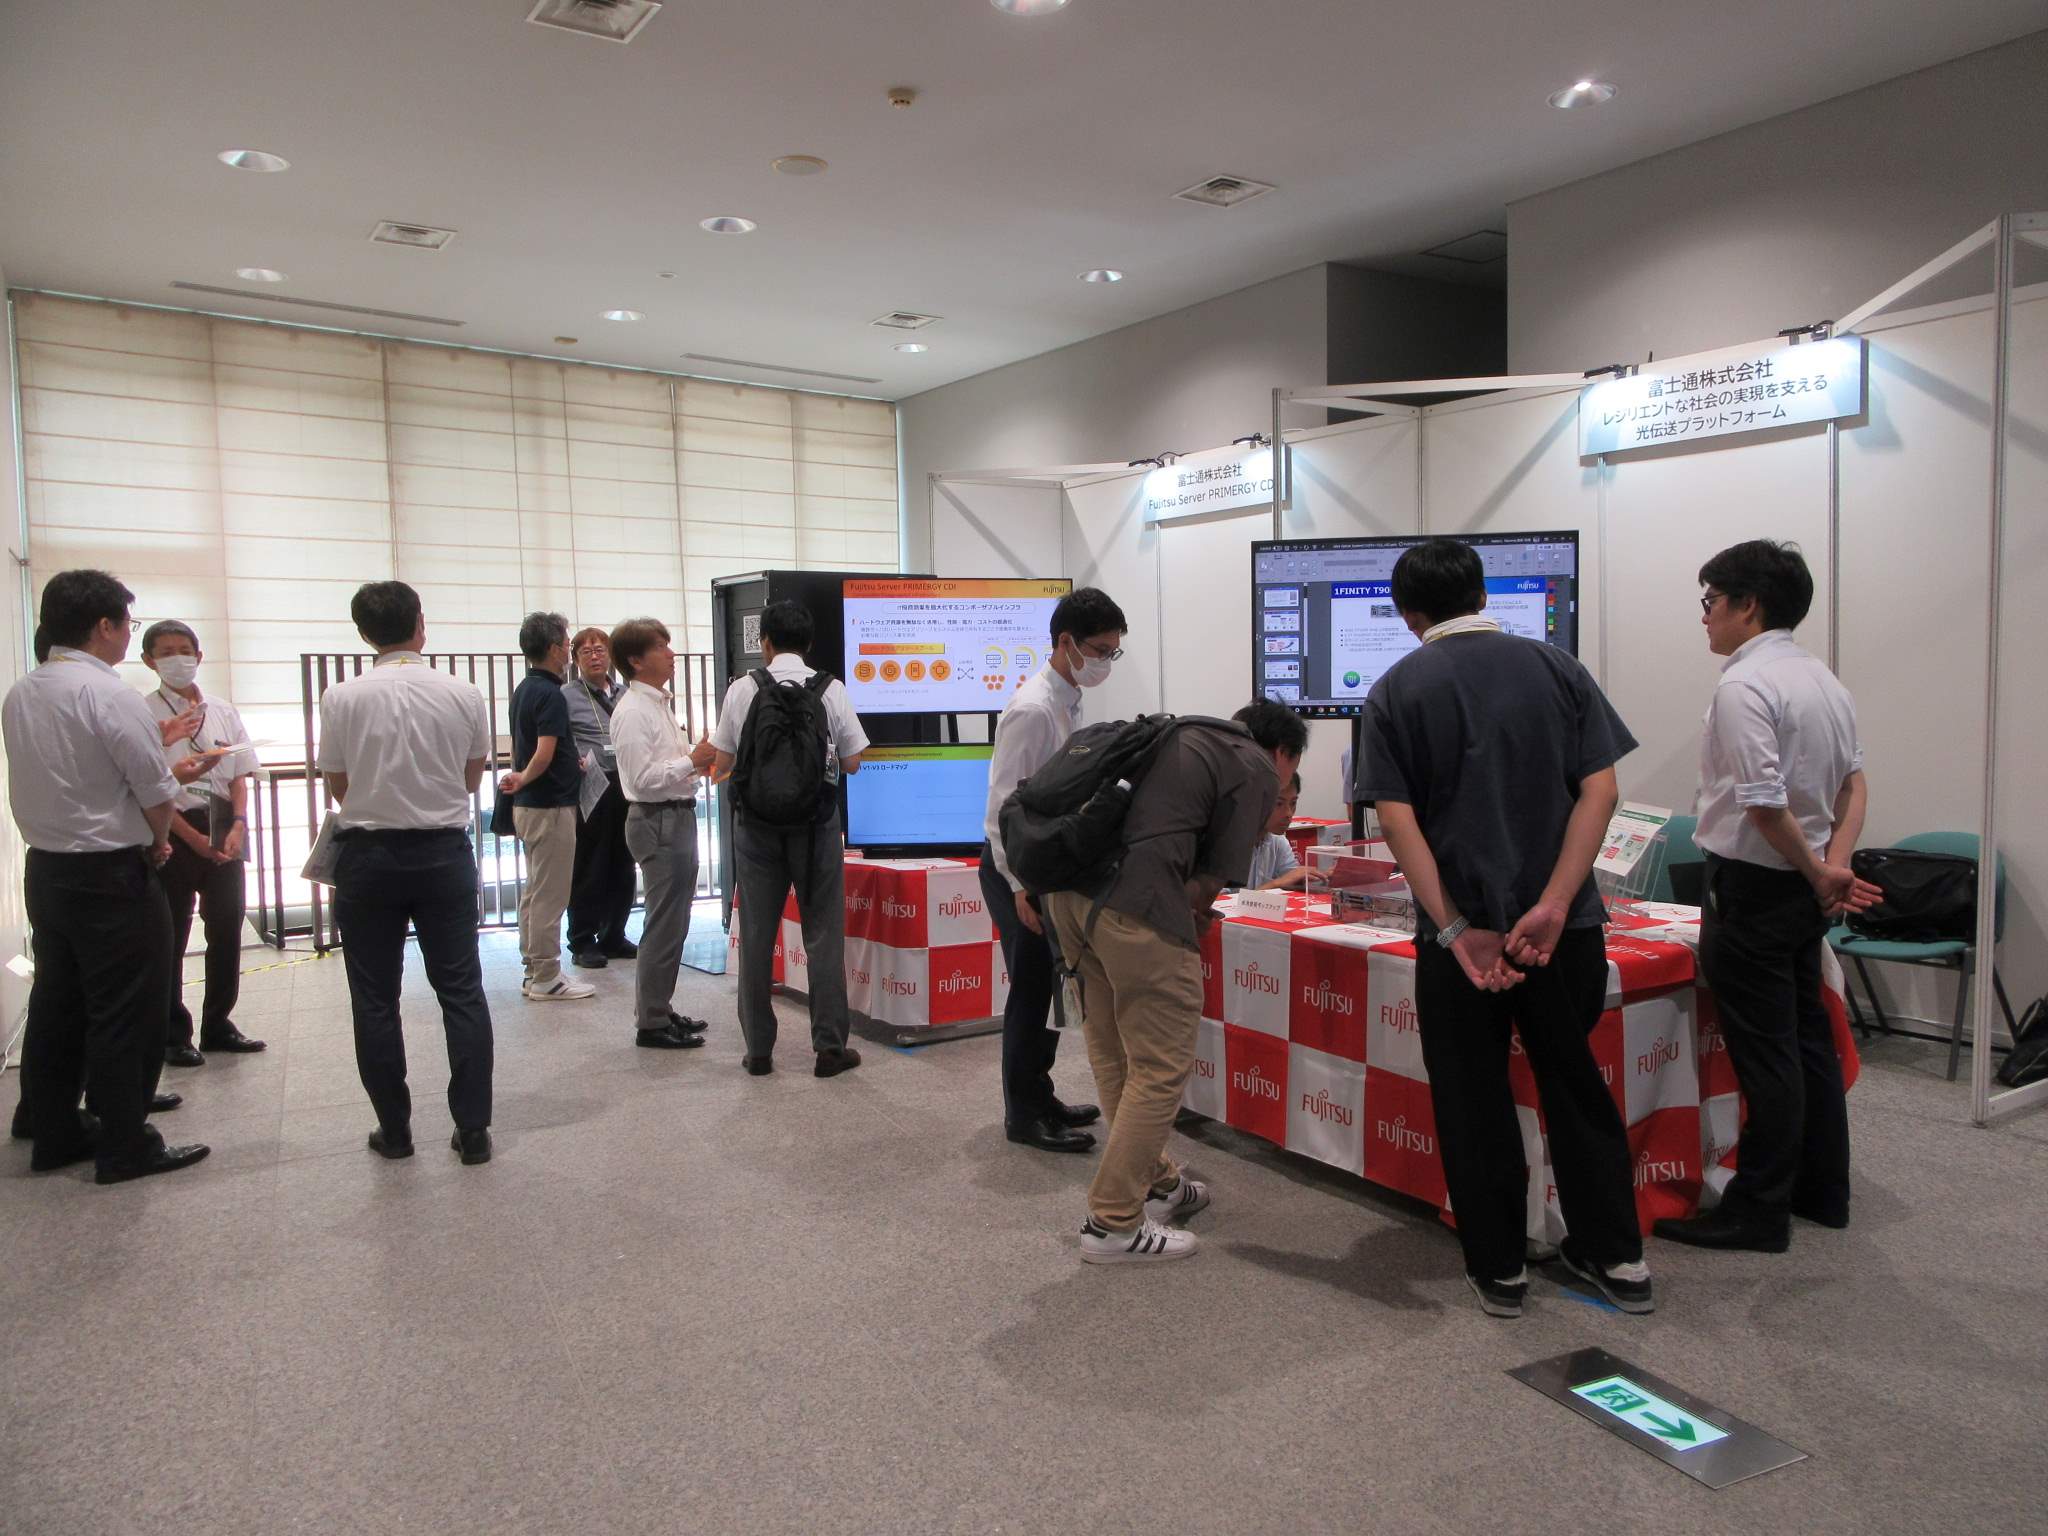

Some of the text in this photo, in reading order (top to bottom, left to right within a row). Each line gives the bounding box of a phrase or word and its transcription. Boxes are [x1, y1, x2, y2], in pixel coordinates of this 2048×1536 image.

[1648, 358, 1773, 398] 富士通株式会社
[1636, 404, 1786, 441] 光伝送プラットフォーム
[1177, 462, 1242, 487] 富士通株式会社
[1148, 479, 1274, 510] Fujitsu Server PRIMERGY CD
[903, 583, 942, 591] PRIMERGY
[1334, 586, 1391, 596] 1FINITY T90
[1517, 579, 1539, 591] FUJITSU
[845, 889, 873, 912] FUJITSU
[882, 896, 917, 919] FUJITSU
[938, 894, 982, 918] FUJITSU
[882, 972, 917, 996] FUJITSU
[938, 969, 982, 994] FUJITSU
[1234, 961, 1279, 995] FUJITSU
[1303, 979, 1354, 1016] FUJITSU
[1381, 998, 1420, 1035] FUJIT
[1638, 1036, 1679, 1075] FUJITSU
[1234, 1065, 1280, 1101] FUJITSU
[1302, 1089, 1353, 1127] FUJITSU
[1377, 1115, 1434, 1154] FUJITSU
